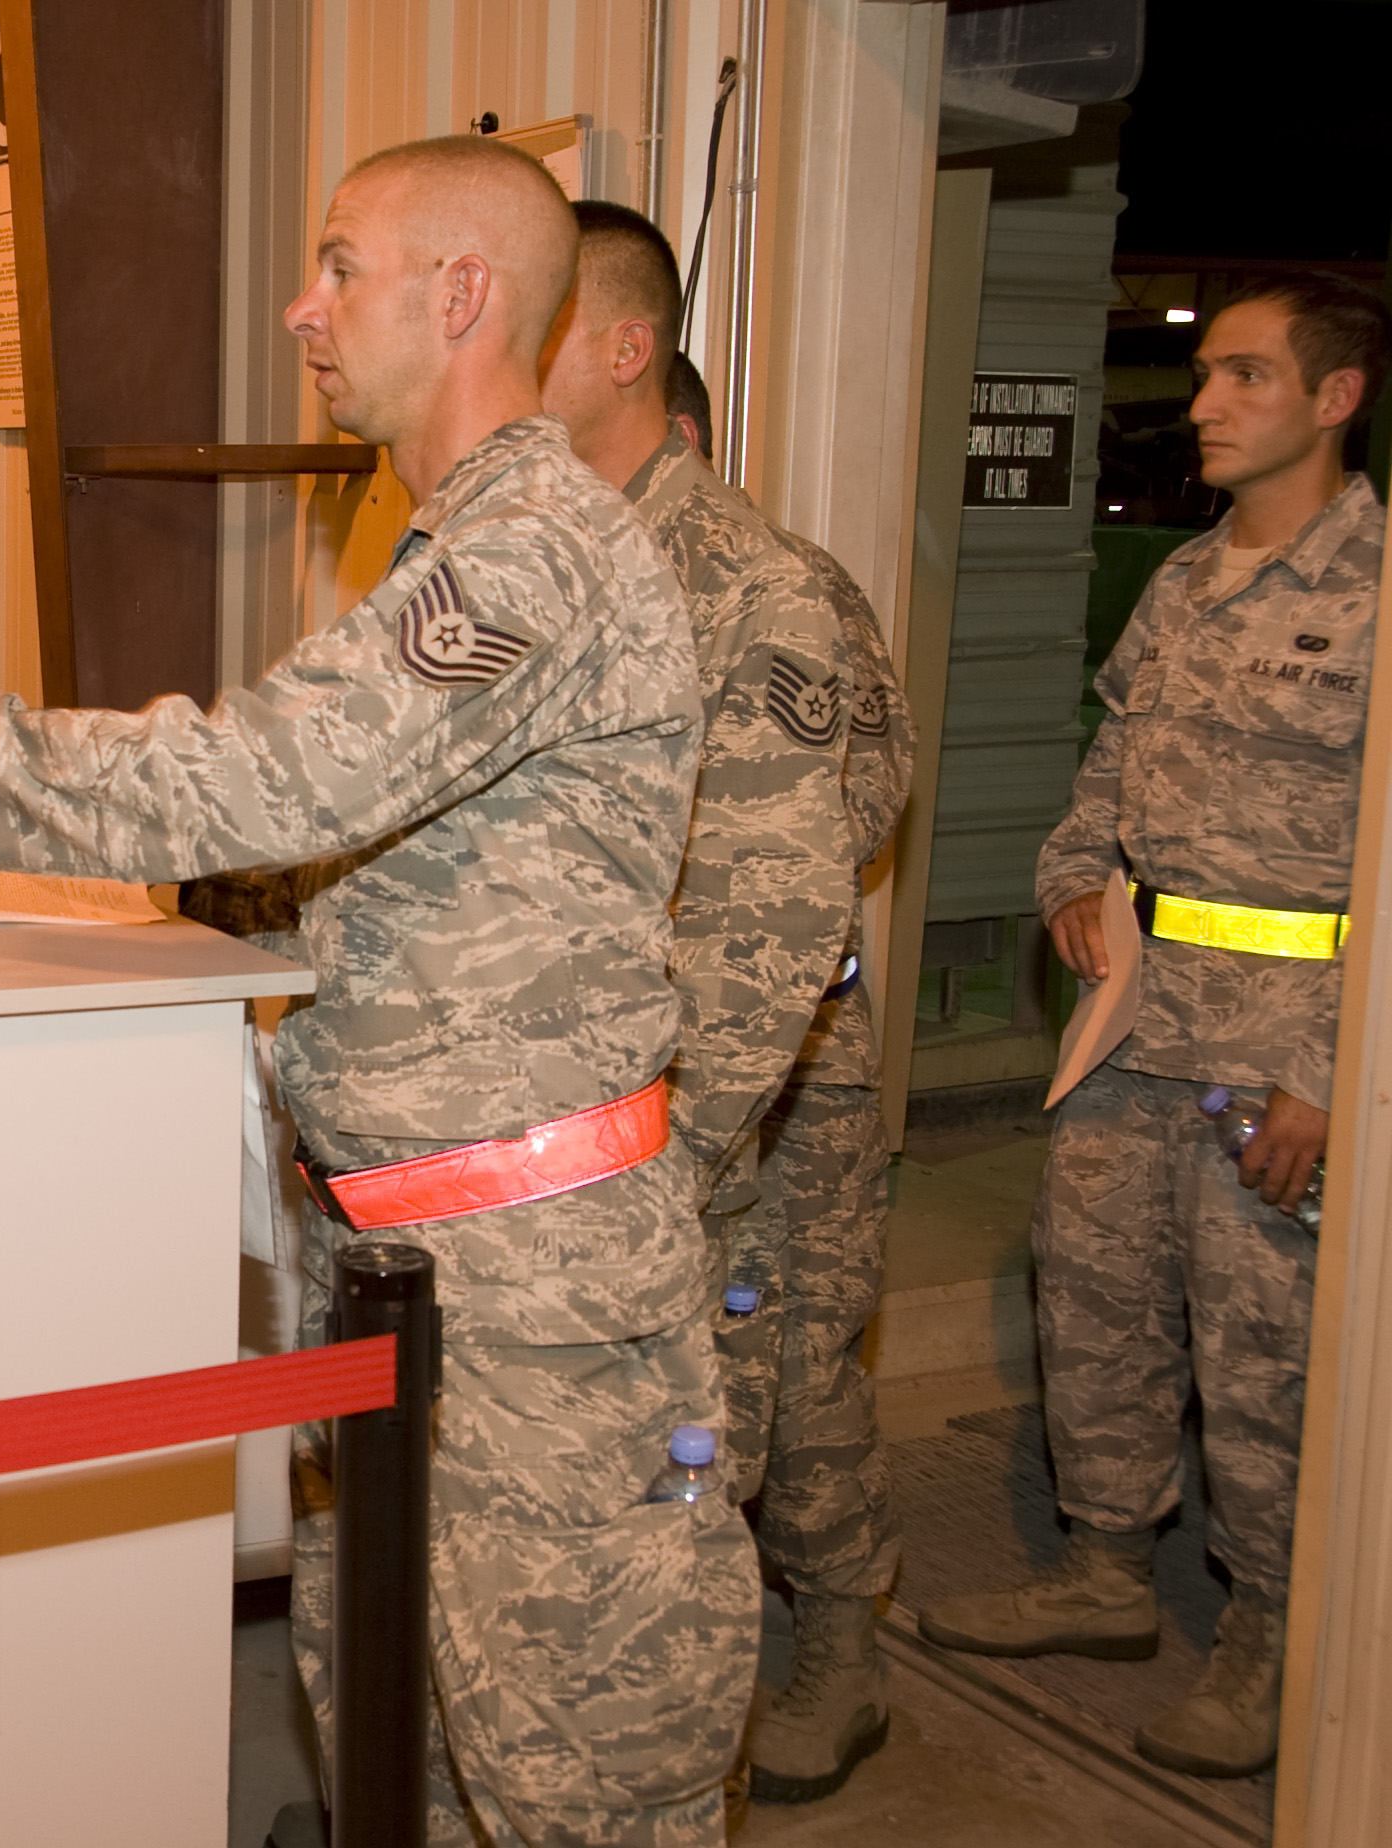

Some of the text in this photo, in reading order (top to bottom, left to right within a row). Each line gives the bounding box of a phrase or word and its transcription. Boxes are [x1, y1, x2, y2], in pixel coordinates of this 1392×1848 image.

[979, 383, 990, 414] OF
[989, 383, 1034, 415] INSTALLATION
[1034, 384, 1075, 415] COMMANDER
[993, 426, 1013, 457] MUST
[1013, 426, 1024, 457] BE
[1023, 426, 1054, 457] GUARDED
[984, 468, 1028, 498] AT ALL TIMES
[1249, 657, 1358, 694] U.S. AIR FORCE
